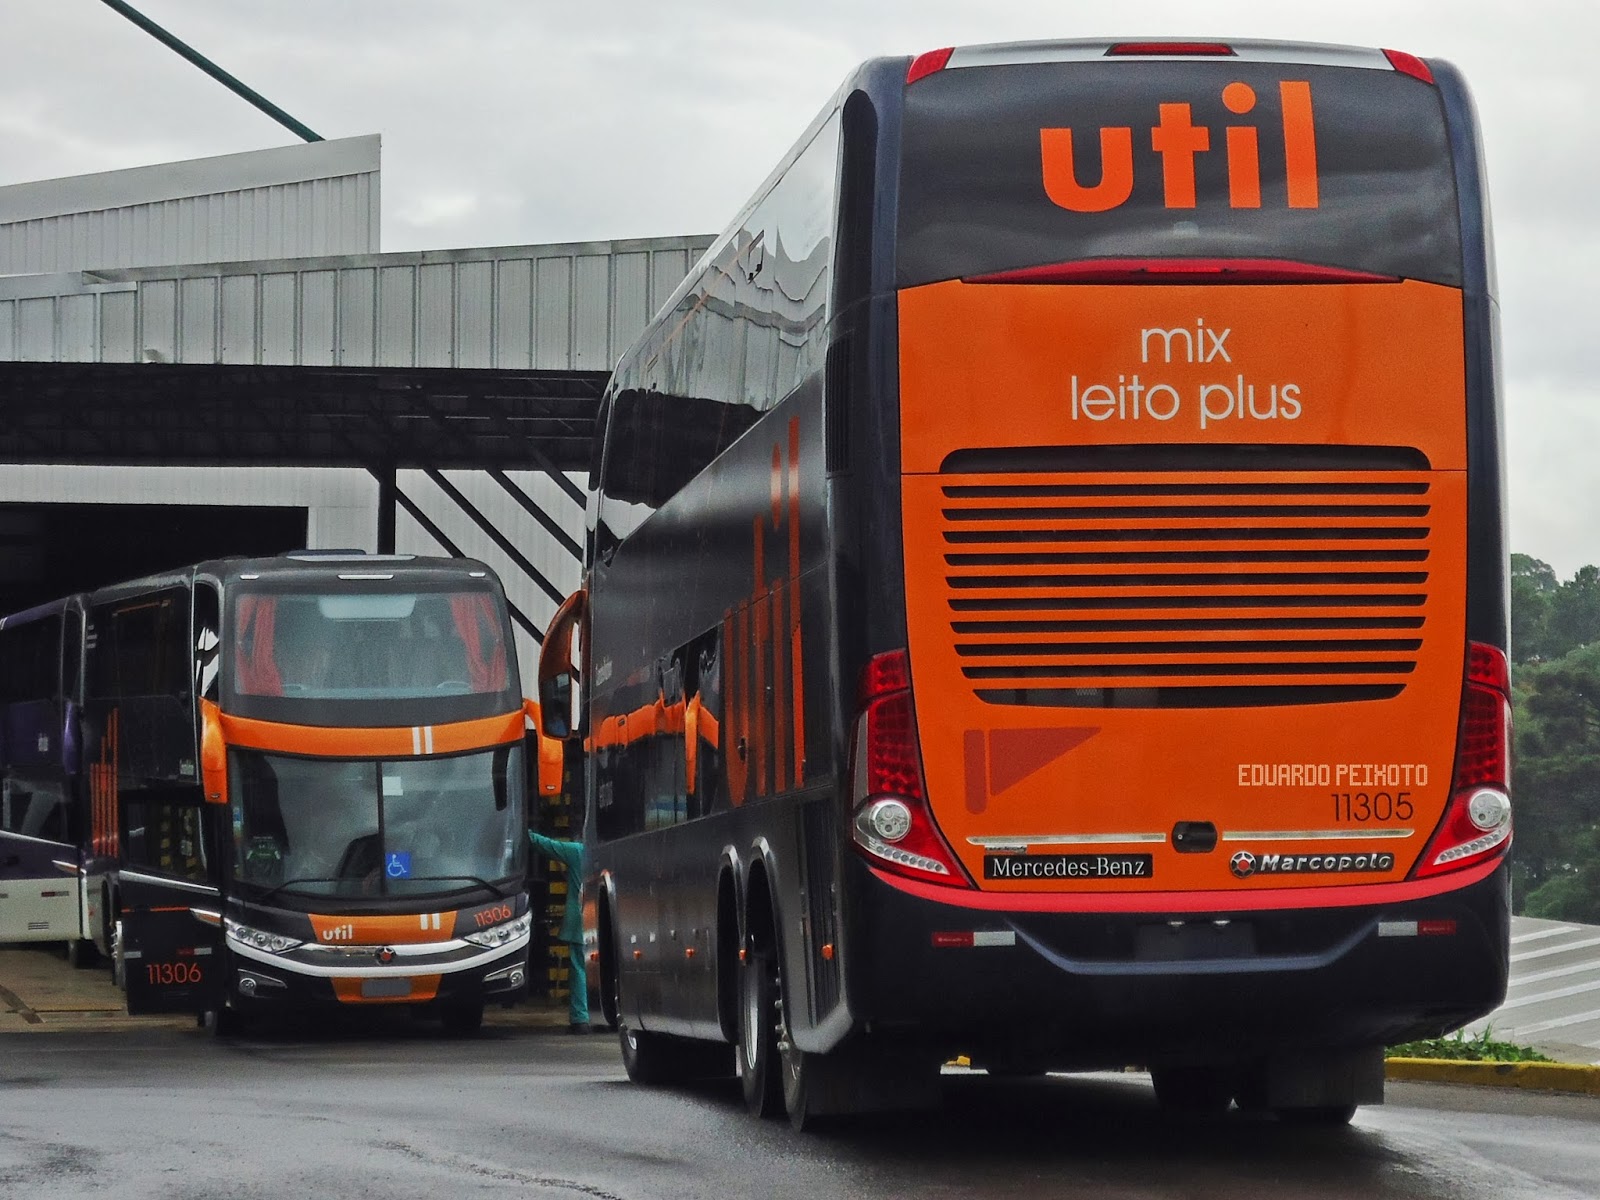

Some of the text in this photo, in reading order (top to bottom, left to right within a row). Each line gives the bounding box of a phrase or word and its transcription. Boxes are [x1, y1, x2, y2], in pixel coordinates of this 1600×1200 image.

[1039, 80, 1319, 213] util
[1141, 317, 1232, 363] mix
[1071, 374, 1302, 430] leito plus
[1238, 764, 1428, 786] EDUARDO PEIXOTO
[1331, 791, 1414, 822] 11305
[992, 857, 1145, 877] Mercedes-Benz
[1260, 853, 1392, 872] Marcopolo
[474, 904, 512, 928] 11306
[322, 924, 353, 941] util
[146, 962, 202, 985] 11306
